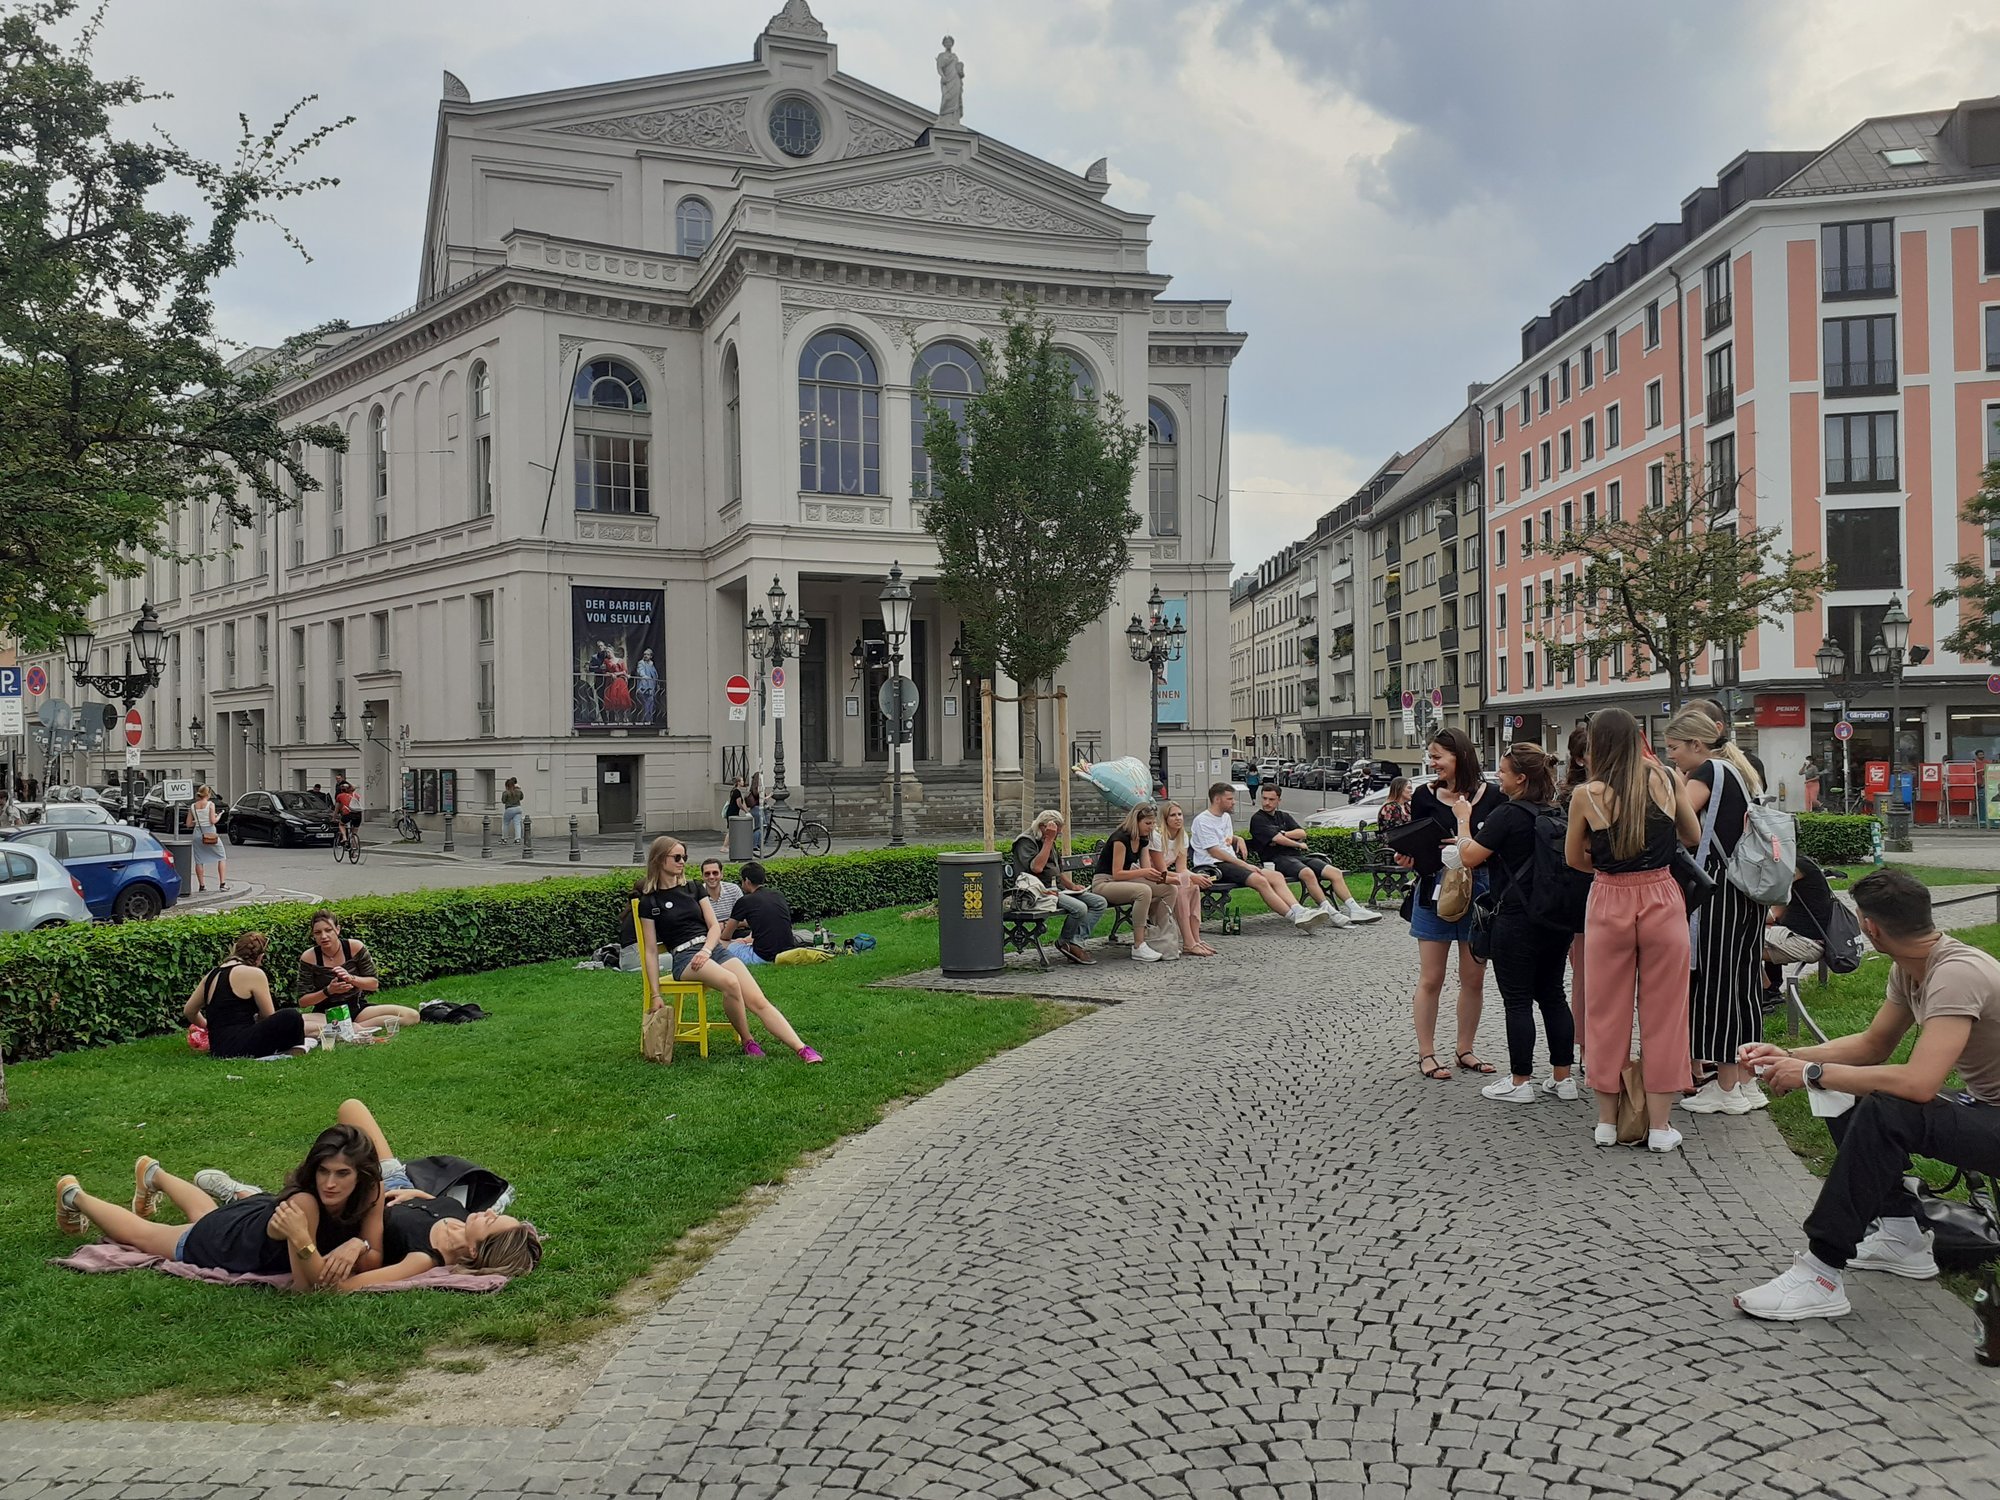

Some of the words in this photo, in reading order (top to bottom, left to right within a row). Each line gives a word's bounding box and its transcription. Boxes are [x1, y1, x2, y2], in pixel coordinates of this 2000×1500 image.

[585, 599, 605, 609] DER
[609, 600, 652, 611] BARBIER
[587, 612, 607, 623] VON
[610, 613, 651, 624] SEVILLA
[1, 670, 15, 693] P
[1850, 711, 1886, 719] Gärtnerplatz
[171, 784, 187, 792] WC
[1815, 1275, 1836, 1292] PUMA
